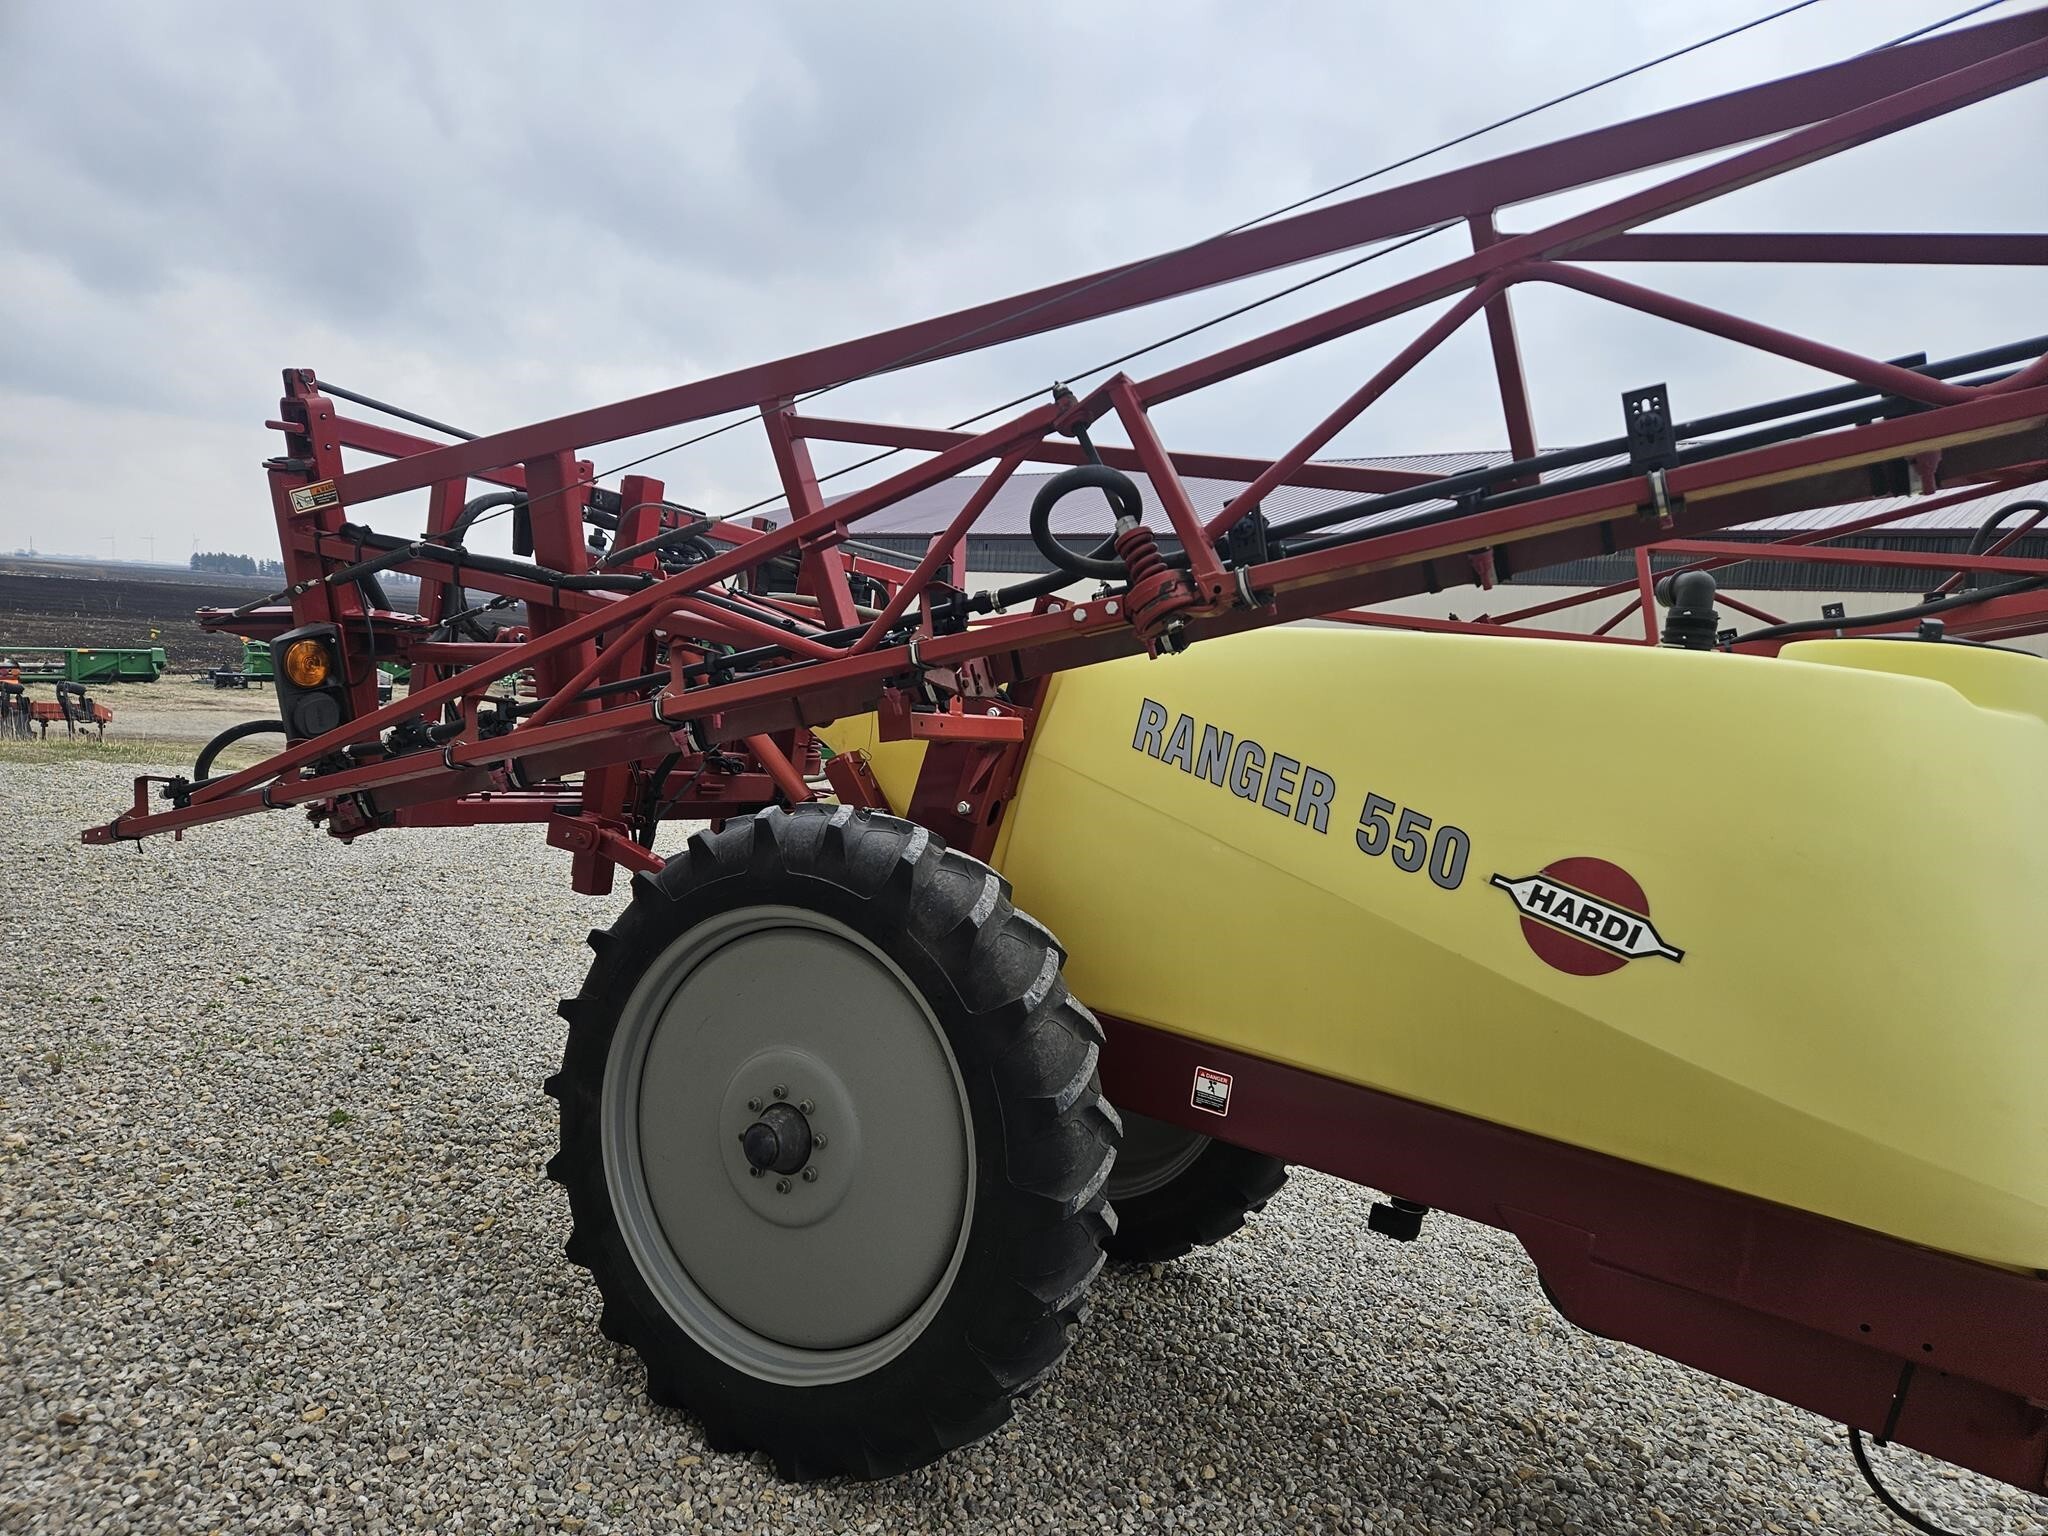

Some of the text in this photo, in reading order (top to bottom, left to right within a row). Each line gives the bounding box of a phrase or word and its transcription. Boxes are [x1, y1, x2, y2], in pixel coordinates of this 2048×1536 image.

[1132, 698, 1470, 890] RANGER 550
[1526, 884, 1643, 949] HARDI
[1205, 1072, 1228, 1083] DANGER
